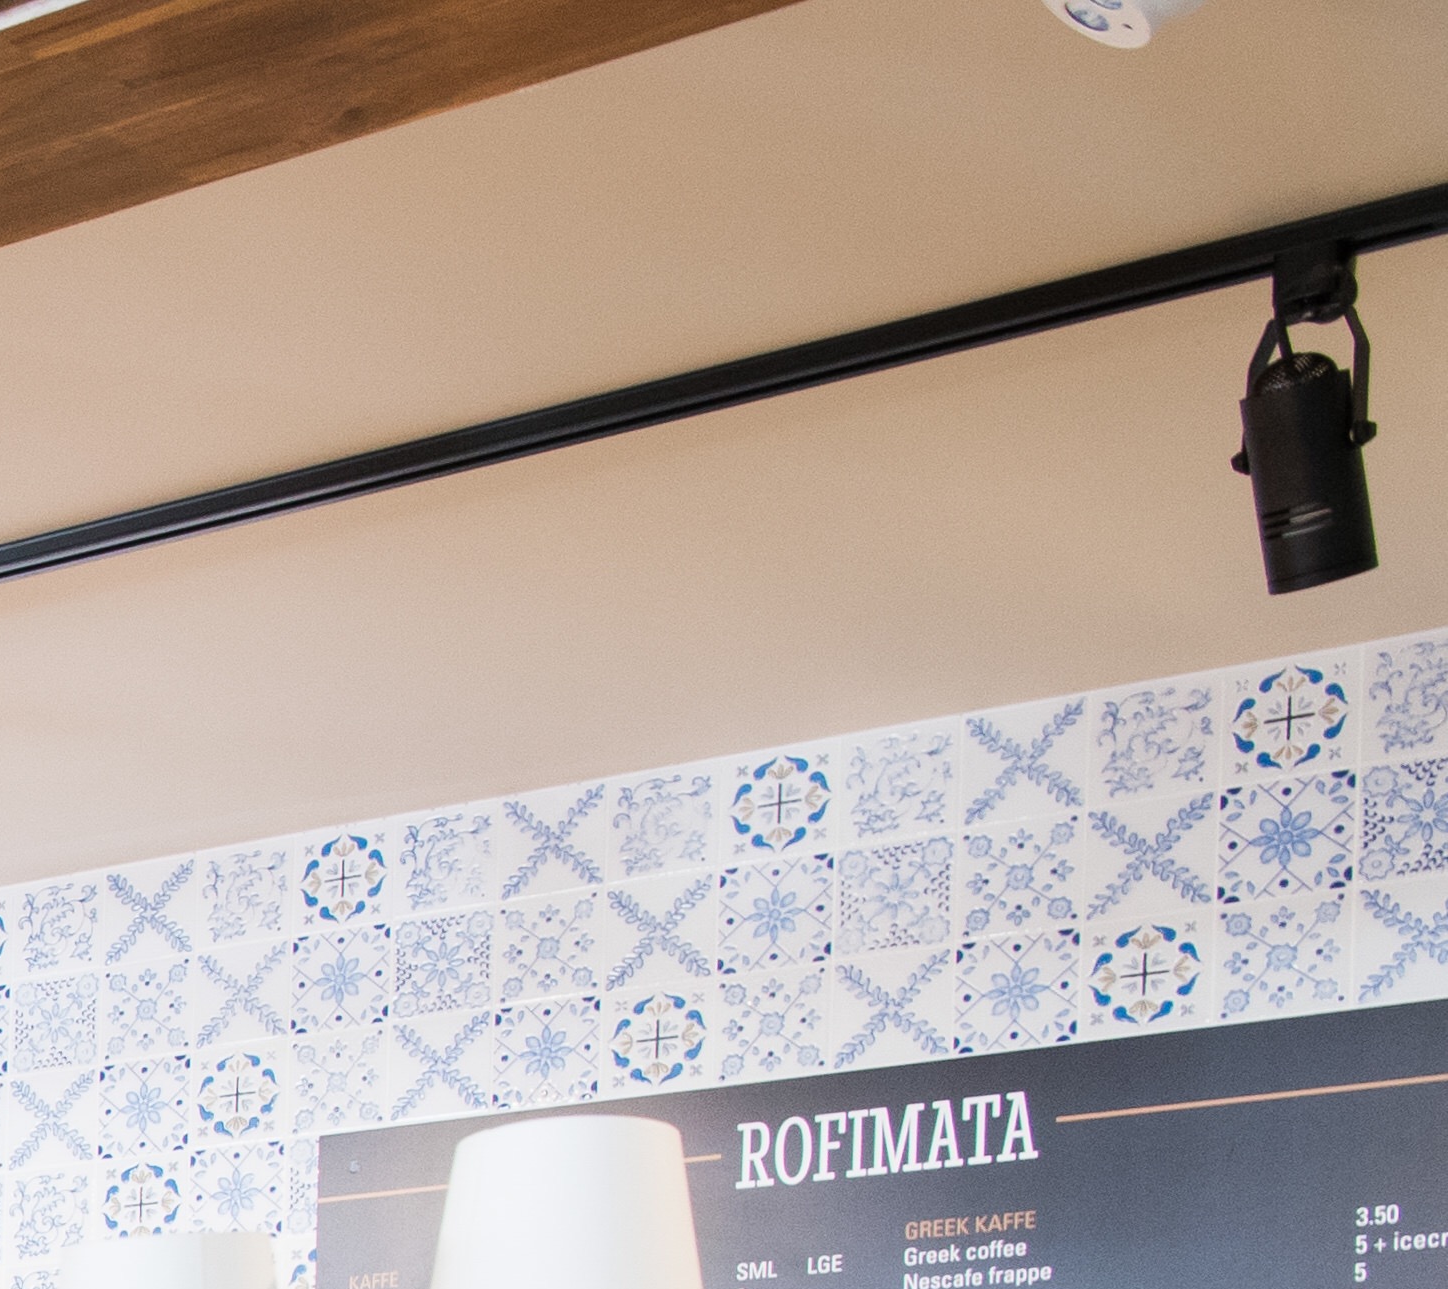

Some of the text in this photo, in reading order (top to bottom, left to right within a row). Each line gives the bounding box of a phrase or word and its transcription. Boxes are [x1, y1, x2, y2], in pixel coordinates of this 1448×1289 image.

[736, 1090, 1039, 1190] ROFIMATA
[904, 1203, 1400, 1241] GREEK KAFFE 3.50
[735, 1253, 844, 1281] SML LGE
[903, 1244, 961, 1267] Greek
[965, 1239, 1028, 1262] coffee
[1354, 1233, 1368, 1256] 5
[988, 1265, 1053, 1287] frappe
[1354, 1262, 1368, 1283] 5
